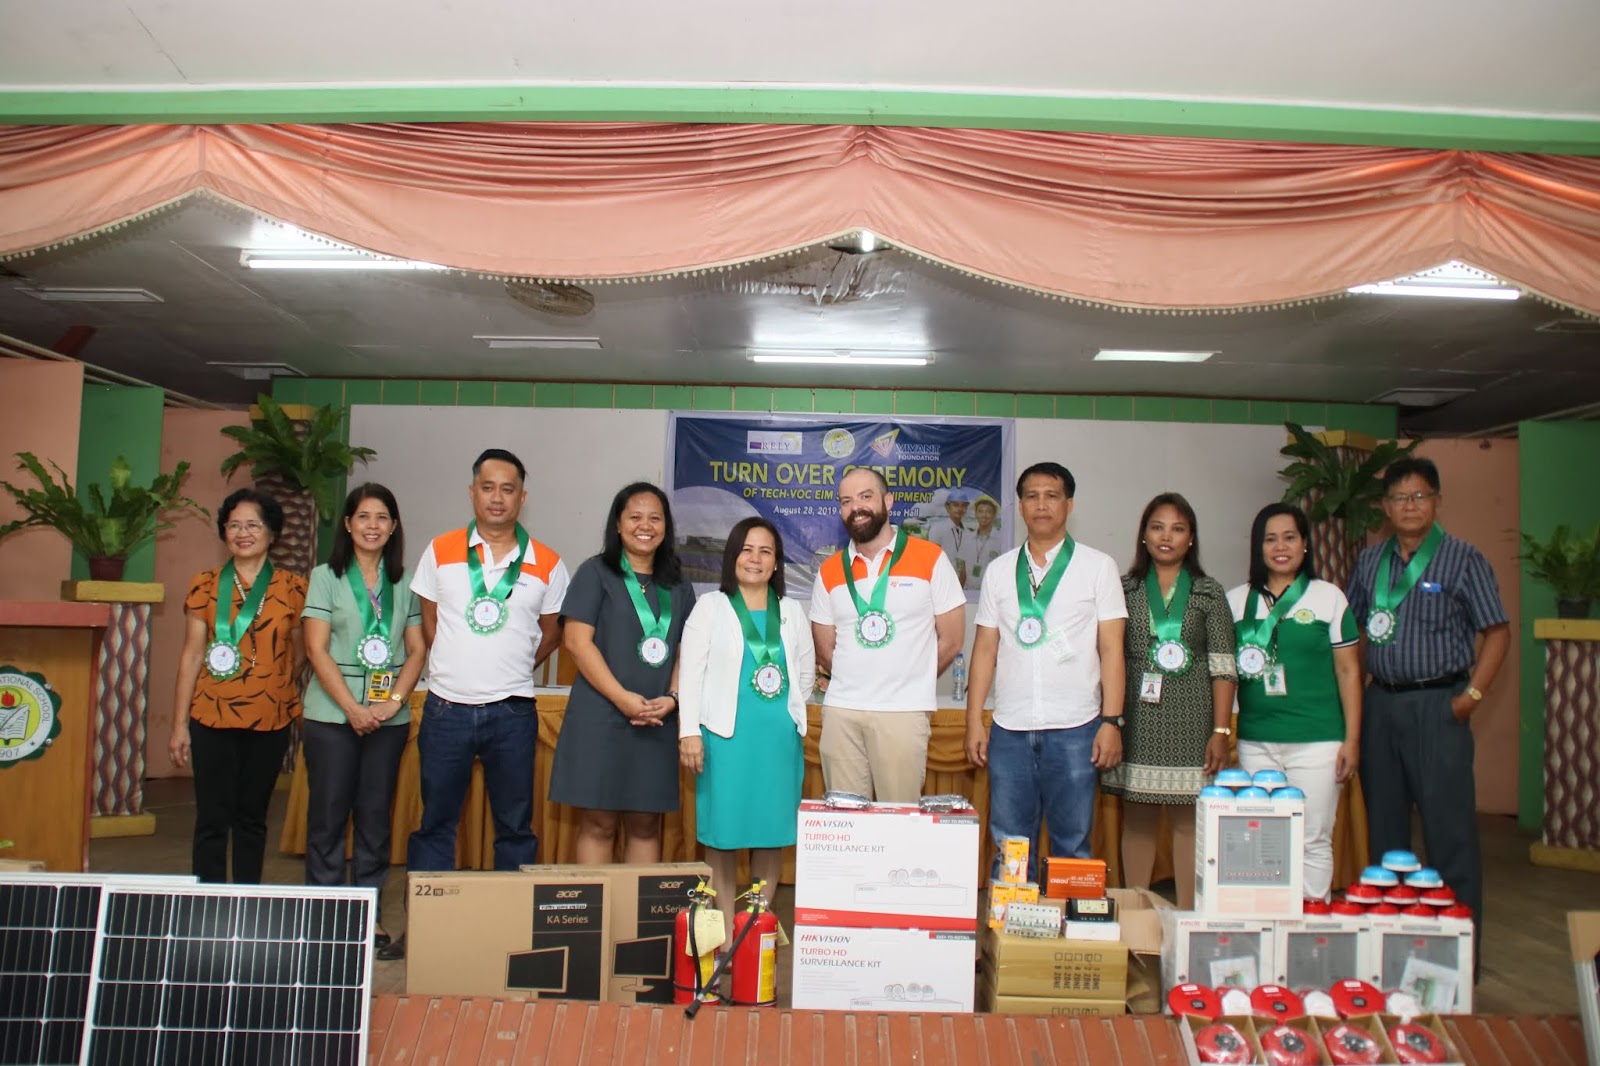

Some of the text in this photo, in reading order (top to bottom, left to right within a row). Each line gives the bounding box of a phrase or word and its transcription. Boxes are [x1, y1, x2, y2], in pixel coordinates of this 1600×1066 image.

[762, 441, 791, 451] RELY
[895, 443, 941, 454] VIVANT
[709, 461, 967, 488] TURN OVER EMONY
[743, 487, 757, 498] OF
[760, 488, 812, 500] TECH-VOC
[815, 490, 834, 500] EIM
[773, 505, 801, 516] August
[803, 506, 815, 515] 28,
[817, 506, 837, 516] 2019
[903, 508, 919, 517] Hall
[0, 675, 51, 724] TIONAL SCHOOL
[0, 748, 19, 758] 907
[804, 819, 854, 828] HIKVISION
[804, 833, 850, 842] TURBO HD
[804, 843, 886, 853] SURVEILLANCE KIT
[415, 884, 431, 896] 22
[659, 881, 684, 889] acer
[556, 890, 582, 899] acer
[650, 905, 664, 914] KA
[546, 914, 589, 924] KA Series
[800, 934, 850, 944] HIKVISION
[800, 948, 831, 956] TURBO
[800, 958, 881, 968] SURVEILLANCE KIT
